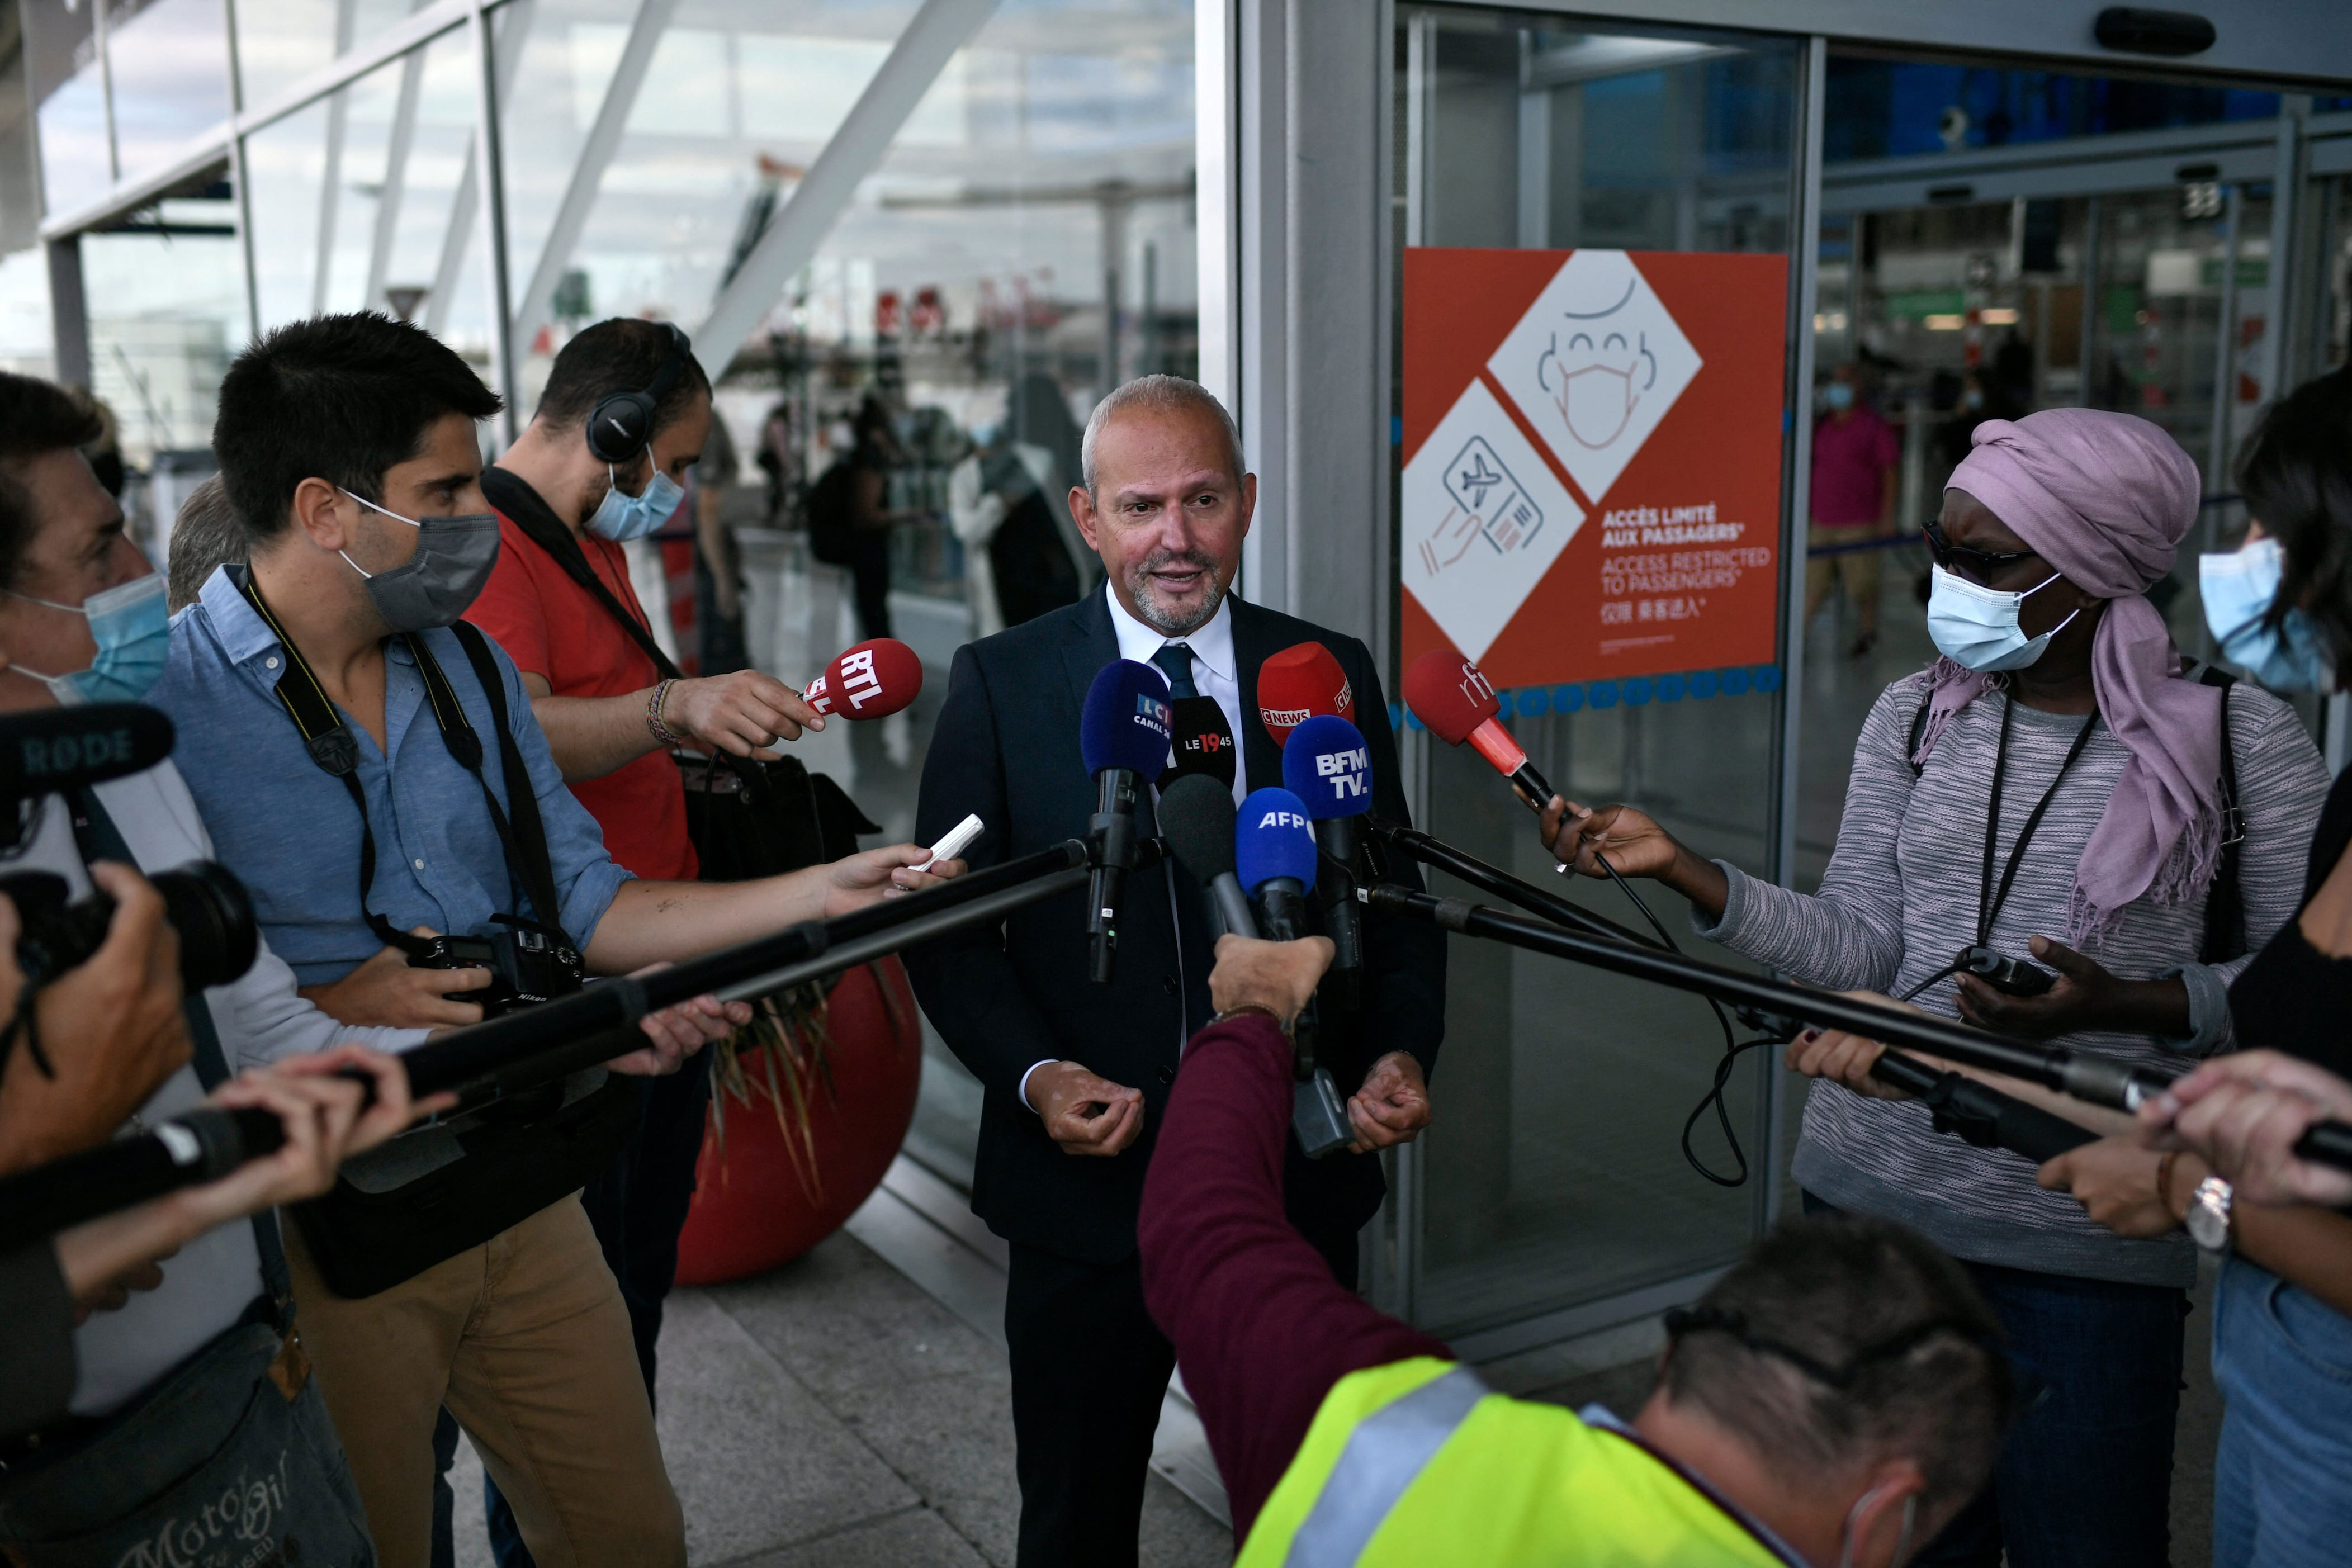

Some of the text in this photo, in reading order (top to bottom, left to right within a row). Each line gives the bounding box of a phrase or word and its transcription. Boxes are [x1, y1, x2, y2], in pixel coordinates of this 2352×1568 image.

[1602, 501, 1717, 528] ACCÈS LIMITÉ
[1601, 528, 1638, 548] AUX
[1601, 547, 1771, 575] ACCESS RESTRICTED
[1601, 575, 1625, 595] TO
[841, 649, 883, 710] RTL
[1459, 662, 1496, 708] rfi
[1144, 699, 1168, 723] LCI
[1134, 716, 1162, 733] CANAL
[1315, 747, 1368, 776] BFM
[1258, 812, 1305, 829] AFP
[518, 993, 548, 1002] Nikon
